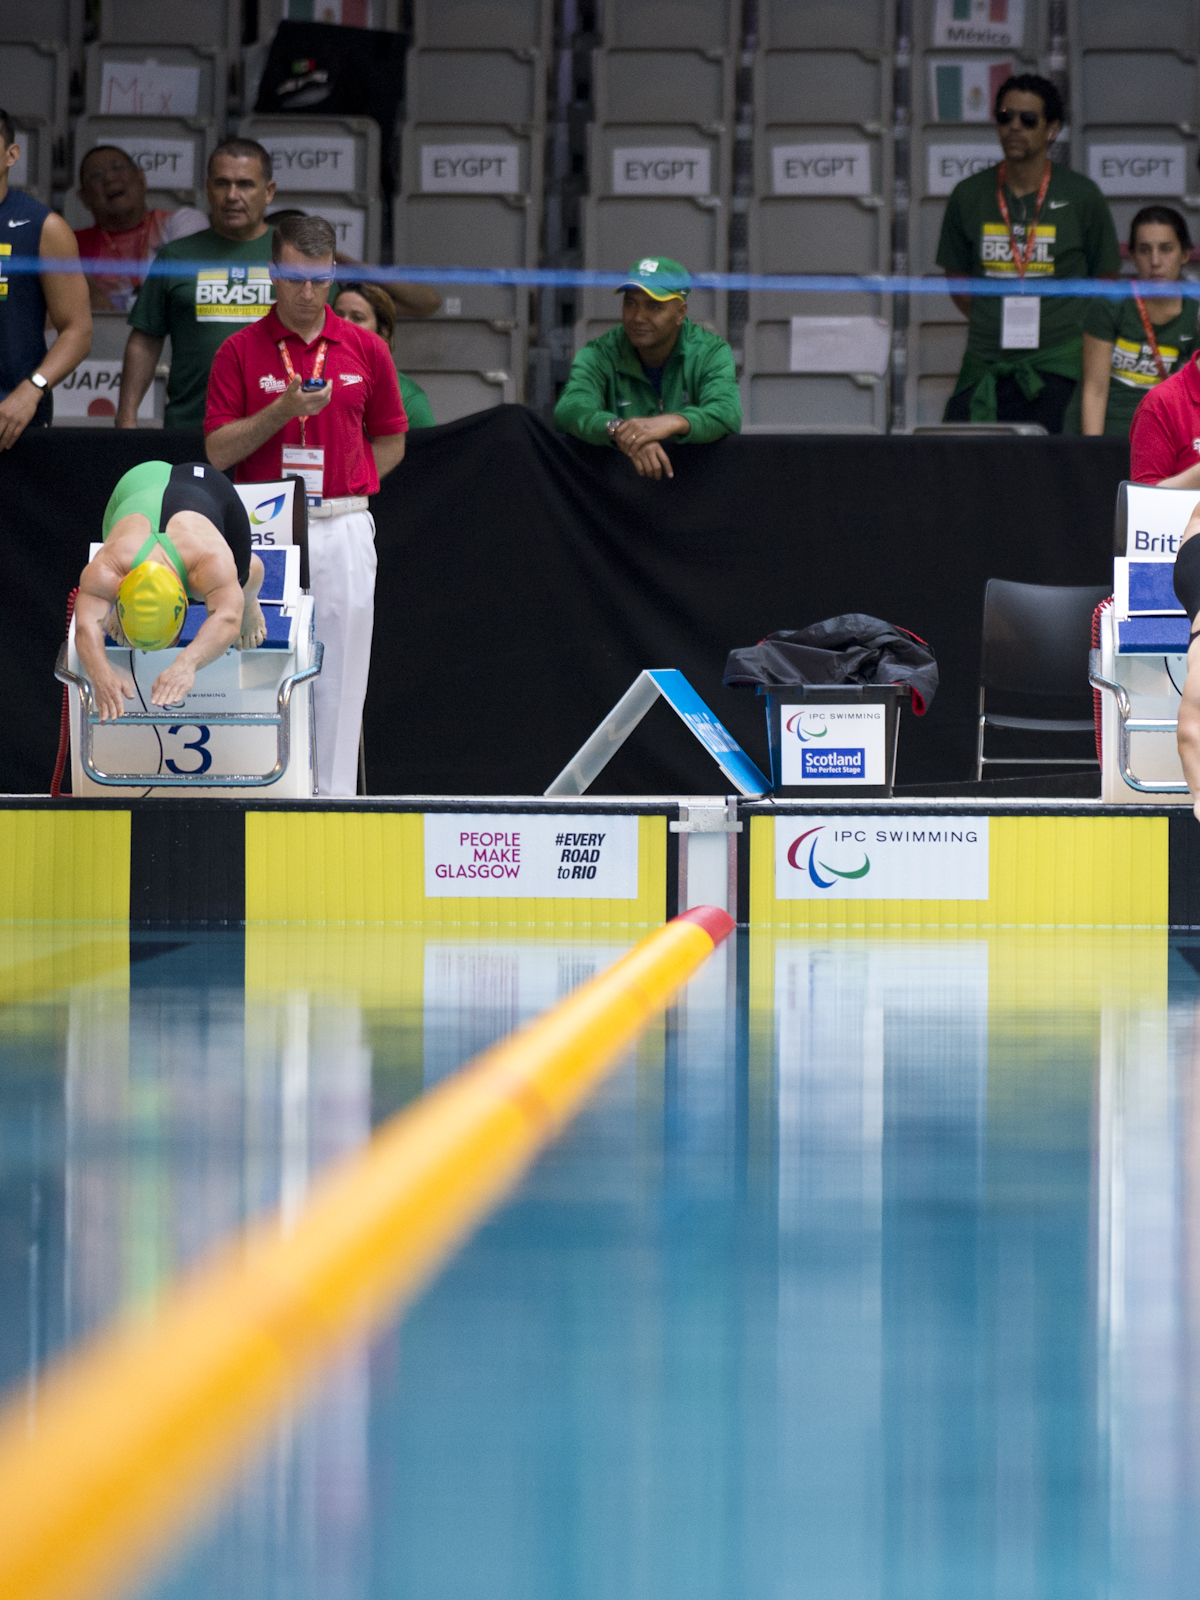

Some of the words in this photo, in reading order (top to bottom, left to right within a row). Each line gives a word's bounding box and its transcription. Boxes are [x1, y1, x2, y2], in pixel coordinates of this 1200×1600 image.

[947, 27, 1011, 45] México
[131, 153, 182, 172] GPT
[270, 151, 343, 171] EYGPT
[433, 157, 507, 178] EYGPT
[785, 157, 858, 179] EYGPT
[940, 158, 999, 178] EYG
[1101, 157, 1175, 178] EYGPT
[625, 160, 700, 181] EYGPT
[196, 285, 278, 305] BRASIL
[199, 306, 251, 315] PARALYMPIC
[1112, 352, 1173, 377] BRASL
[63, 371, 122, 390] JAPA
[340, 374, 362, 382] speedo
[251, 531, 275, 545] as
[1135, 530, 1183, 553] Briti
[164, 725, 213, 774] 3
[805, 752, 861, 766] Scotland
[460, 832, 520, 847] PEOPLE
[555, 833, 606, 846] #EVERY
[834, 831, 866, 842] IPC
[876, 831, 978, 842] SWIMMING
[473, 849, 520, 863] MAKE
[560, 849, 600, 863] ROAD
[435, 864, 520, 878] GLASGOW
[557, 866, 570, 879] to
[571, 865, 597, 879] RIO
